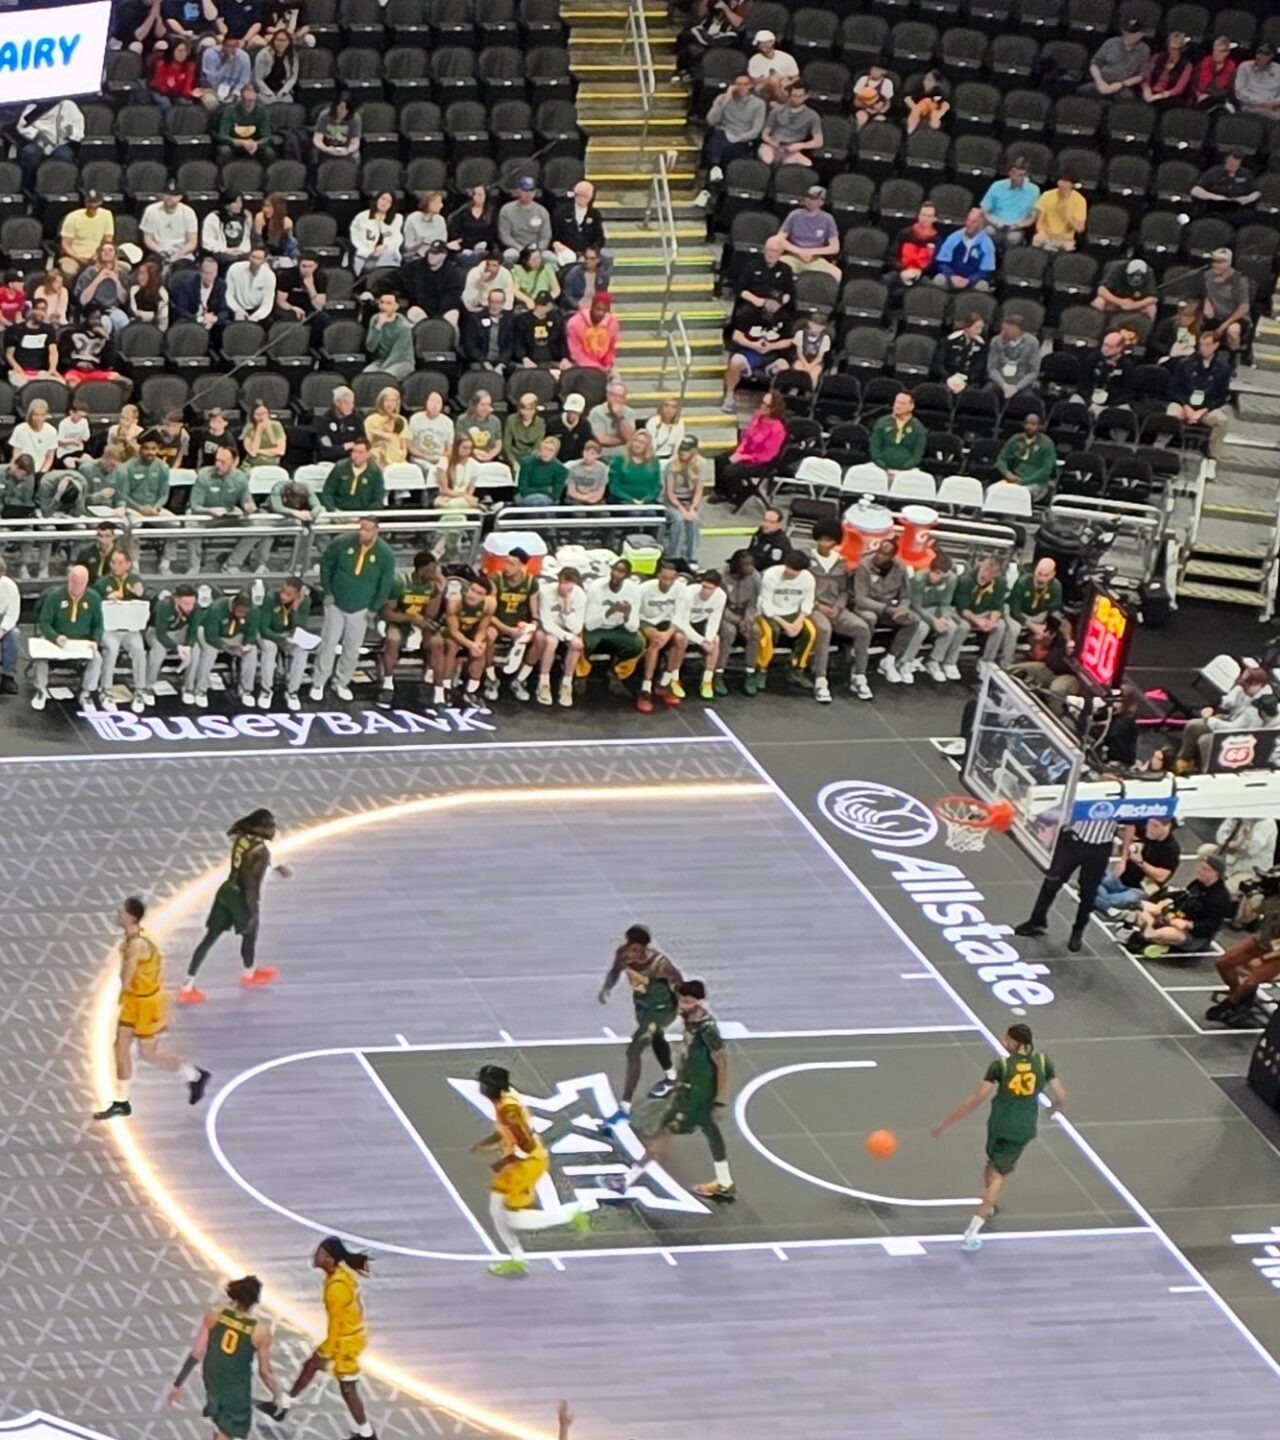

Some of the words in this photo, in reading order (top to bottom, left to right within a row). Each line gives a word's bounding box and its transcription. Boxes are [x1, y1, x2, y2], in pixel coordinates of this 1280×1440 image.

[1113, 802, 1168, 818] Allstate
[871, 849, 1055, 1006] Allstate
[1008, 1071, 1037, 1096] 43
[220, 1328, 240, 1355] 0
